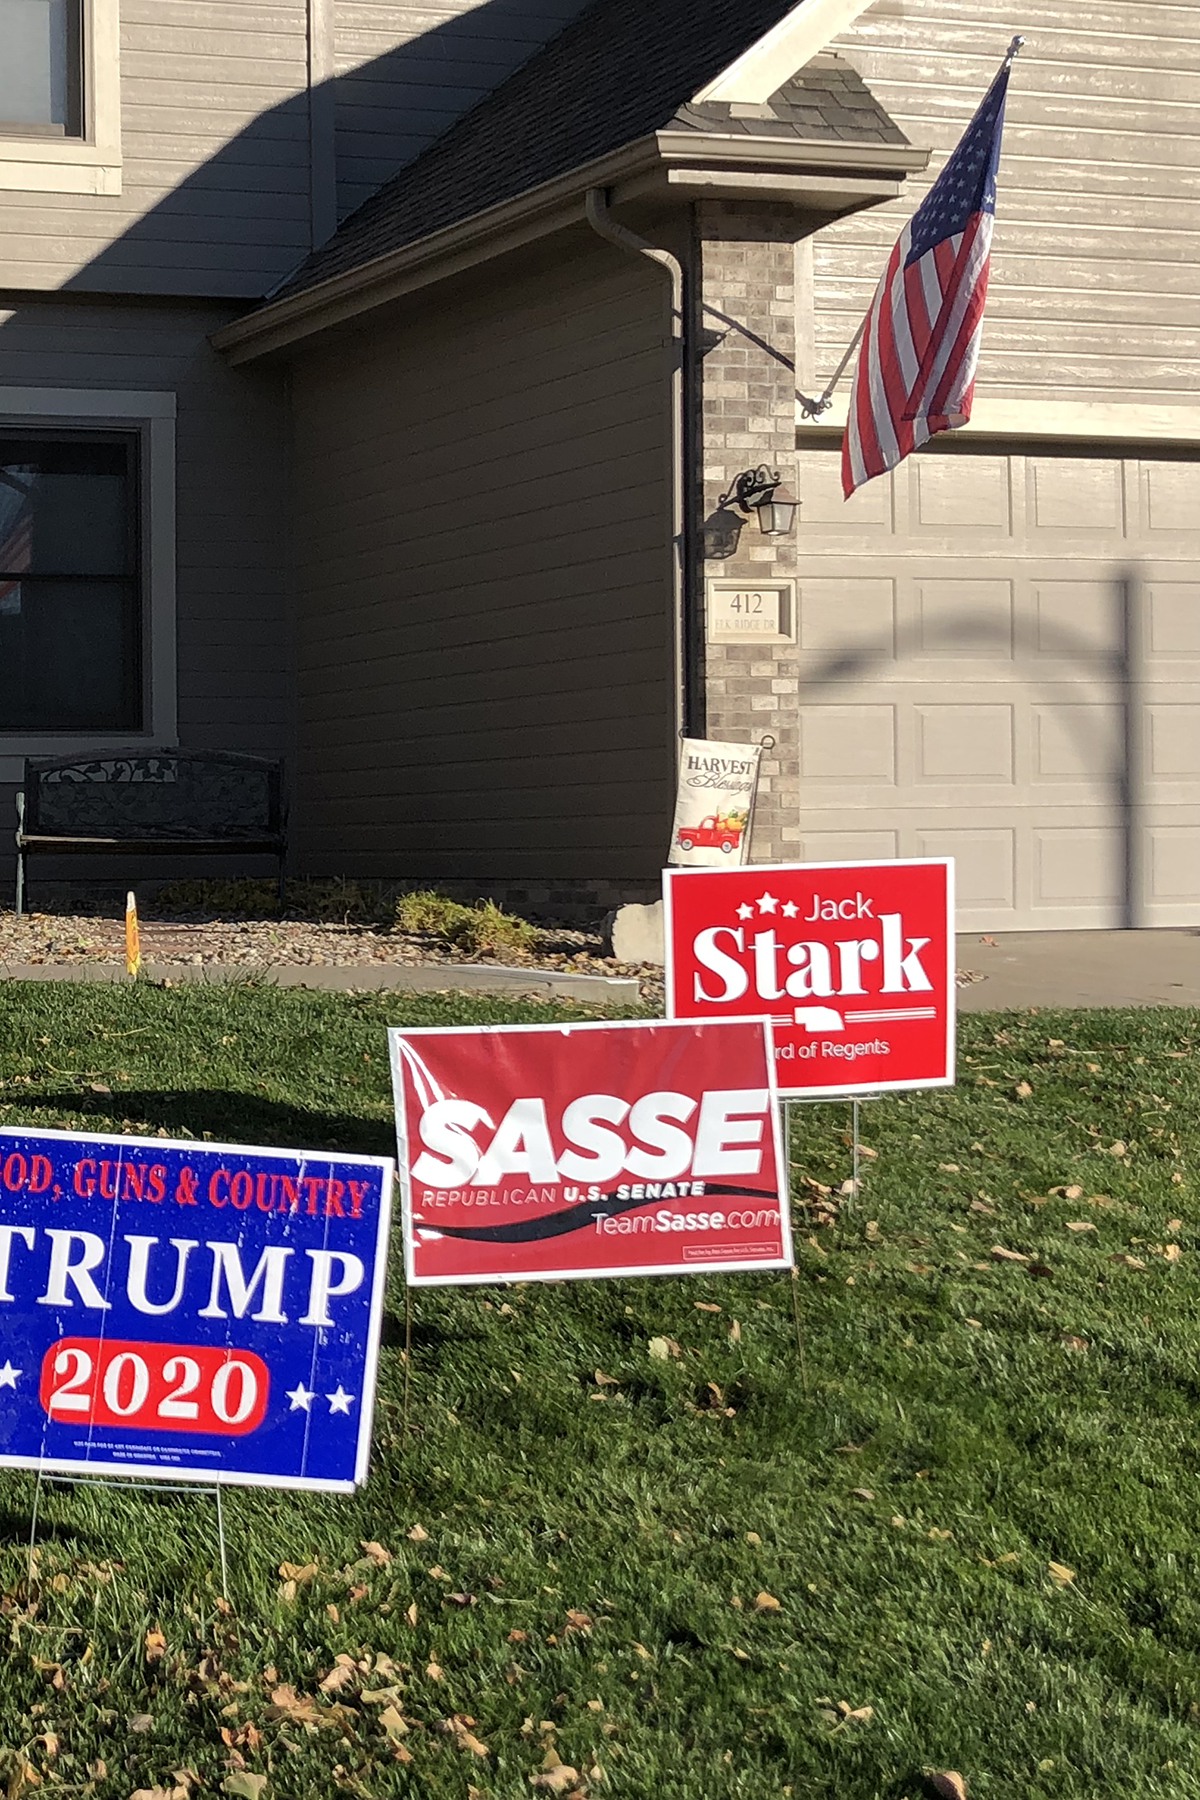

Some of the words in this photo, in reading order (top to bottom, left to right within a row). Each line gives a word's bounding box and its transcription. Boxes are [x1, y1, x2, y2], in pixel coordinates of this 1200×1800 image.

[730, 593, 763, 613] 412
[687, 755, 754, 775] HARVEST
[804, 892, 874, 922] Jack
[693, 913, 934, 1003] Stark
[798, 1041, 818, 1059] of
[821, 1038, 890, 1060] Regents
[410, 1088, 770, 1188] SASSE
[74, 1158, 168, 1203] GUNS
[175, 1166, 199, 1206] &
[208, 1168, 370, 1218] COUNTRY
[421, 1186, 557, 1208] REPUBLICAN
[563, 1185, 609, 1203] U.S.
[616, 1180, 707, 1200] SENATE
[591, 1207, 780, 1236] TeamSasse.com
[48, 1347, 258, 1424] 2020
